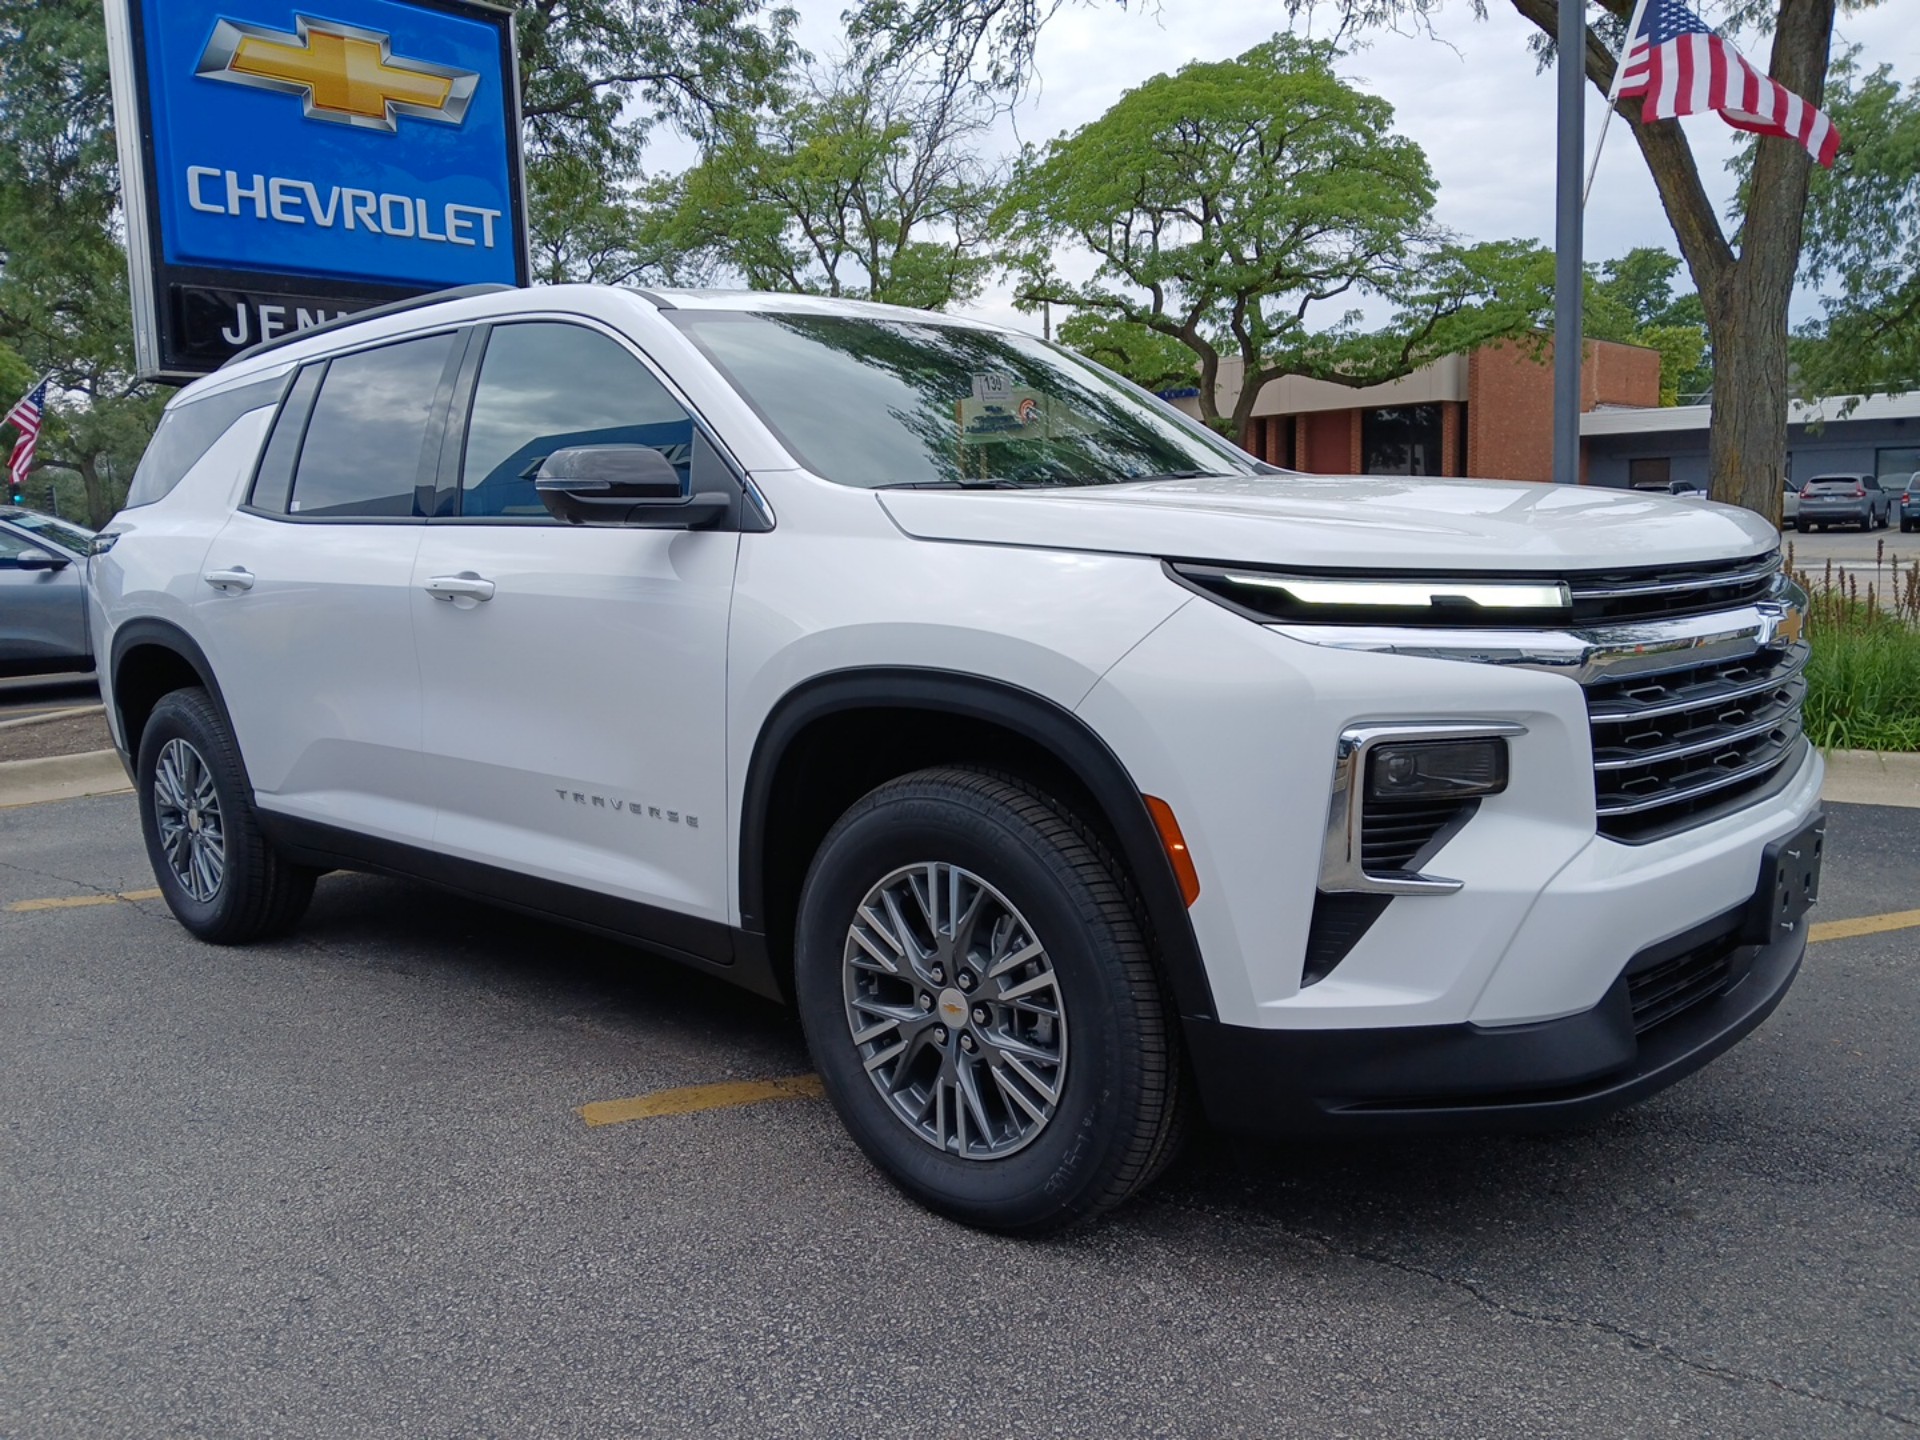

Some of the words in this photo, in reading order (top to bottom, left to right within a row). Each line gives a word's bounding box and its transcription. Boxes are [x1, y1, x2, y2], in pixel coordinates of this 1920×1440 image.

[187, 165, 501, 248] CHEVROLET
[221, 302, 350, 345] JEN
[555, 789, 699, 828] TRAVERSE
